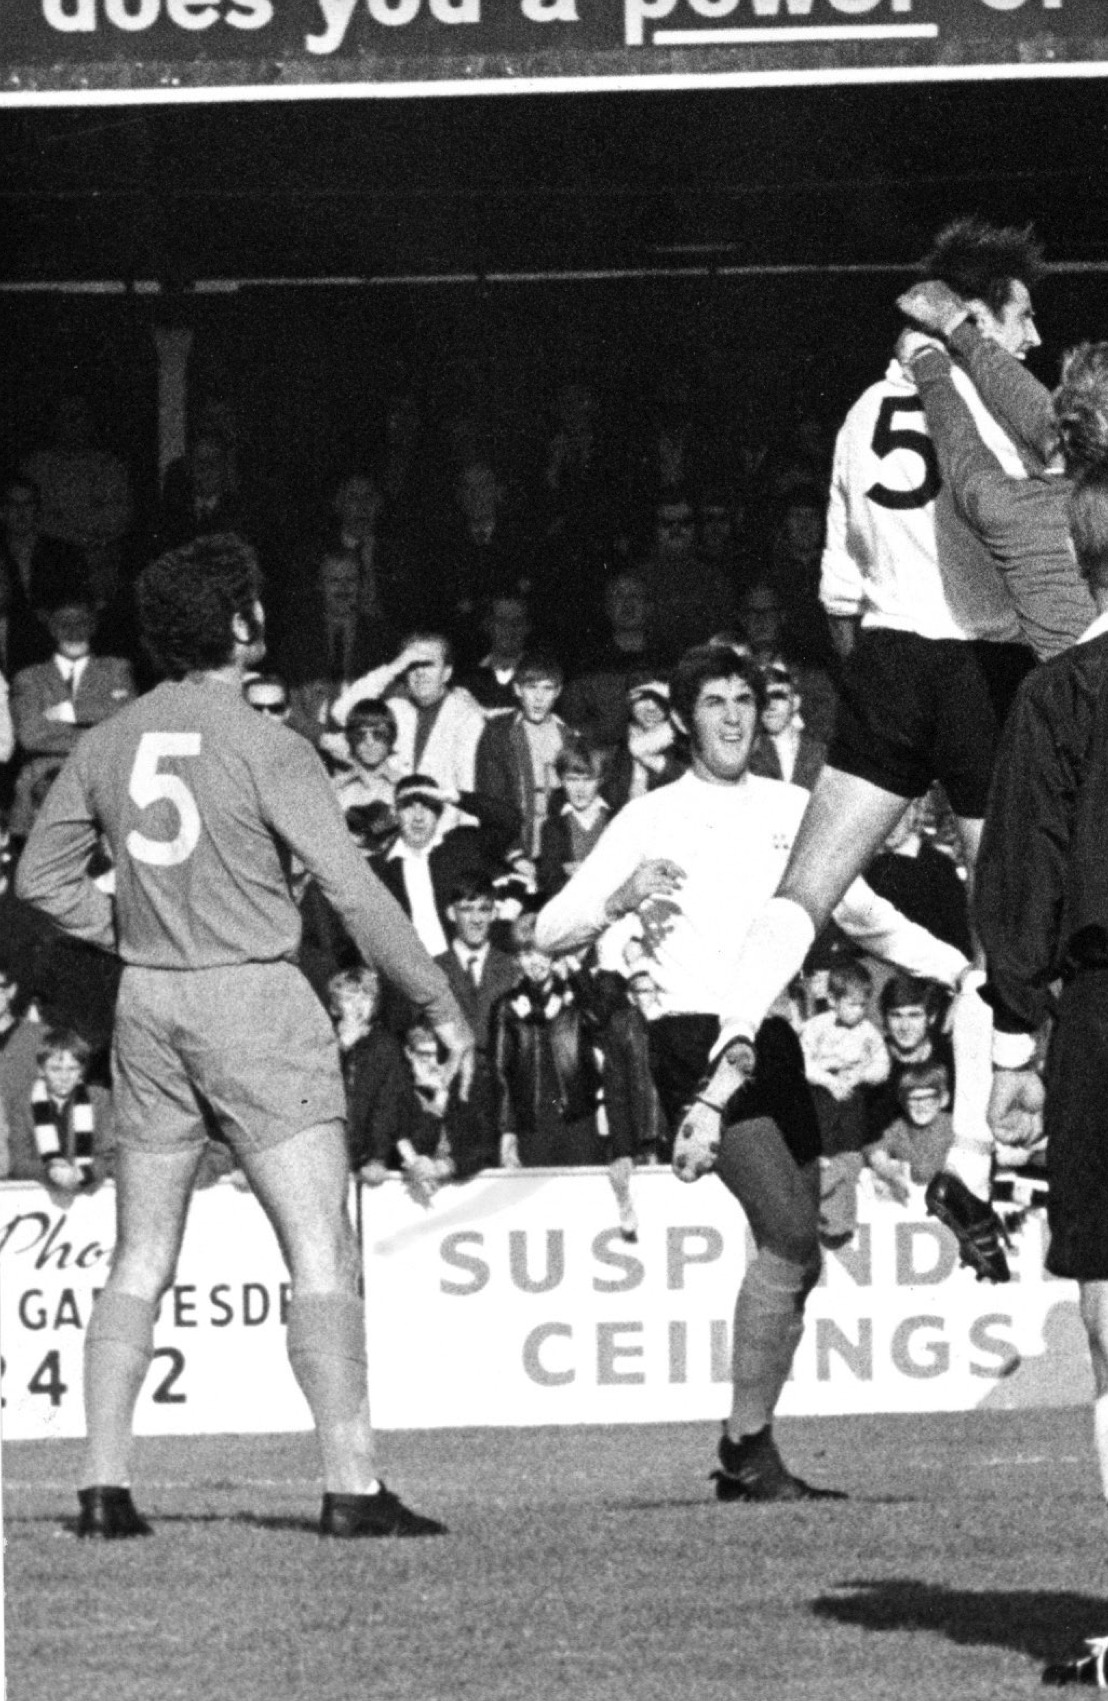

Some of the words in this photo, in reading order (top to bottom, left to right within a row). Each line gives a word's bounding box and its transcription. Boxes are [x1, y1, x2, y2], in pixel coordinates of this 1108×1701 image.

[864, 393, 943, 510] 5
[126, 732, 202, 866] 5
[0, 1211, 114, 1270] Pho
[439, 1219, 1072, 1297] SUSPND
[18, 1282, 293, 1331] GAESD
[522, 1313, 1019, 1387] CEILNGS
